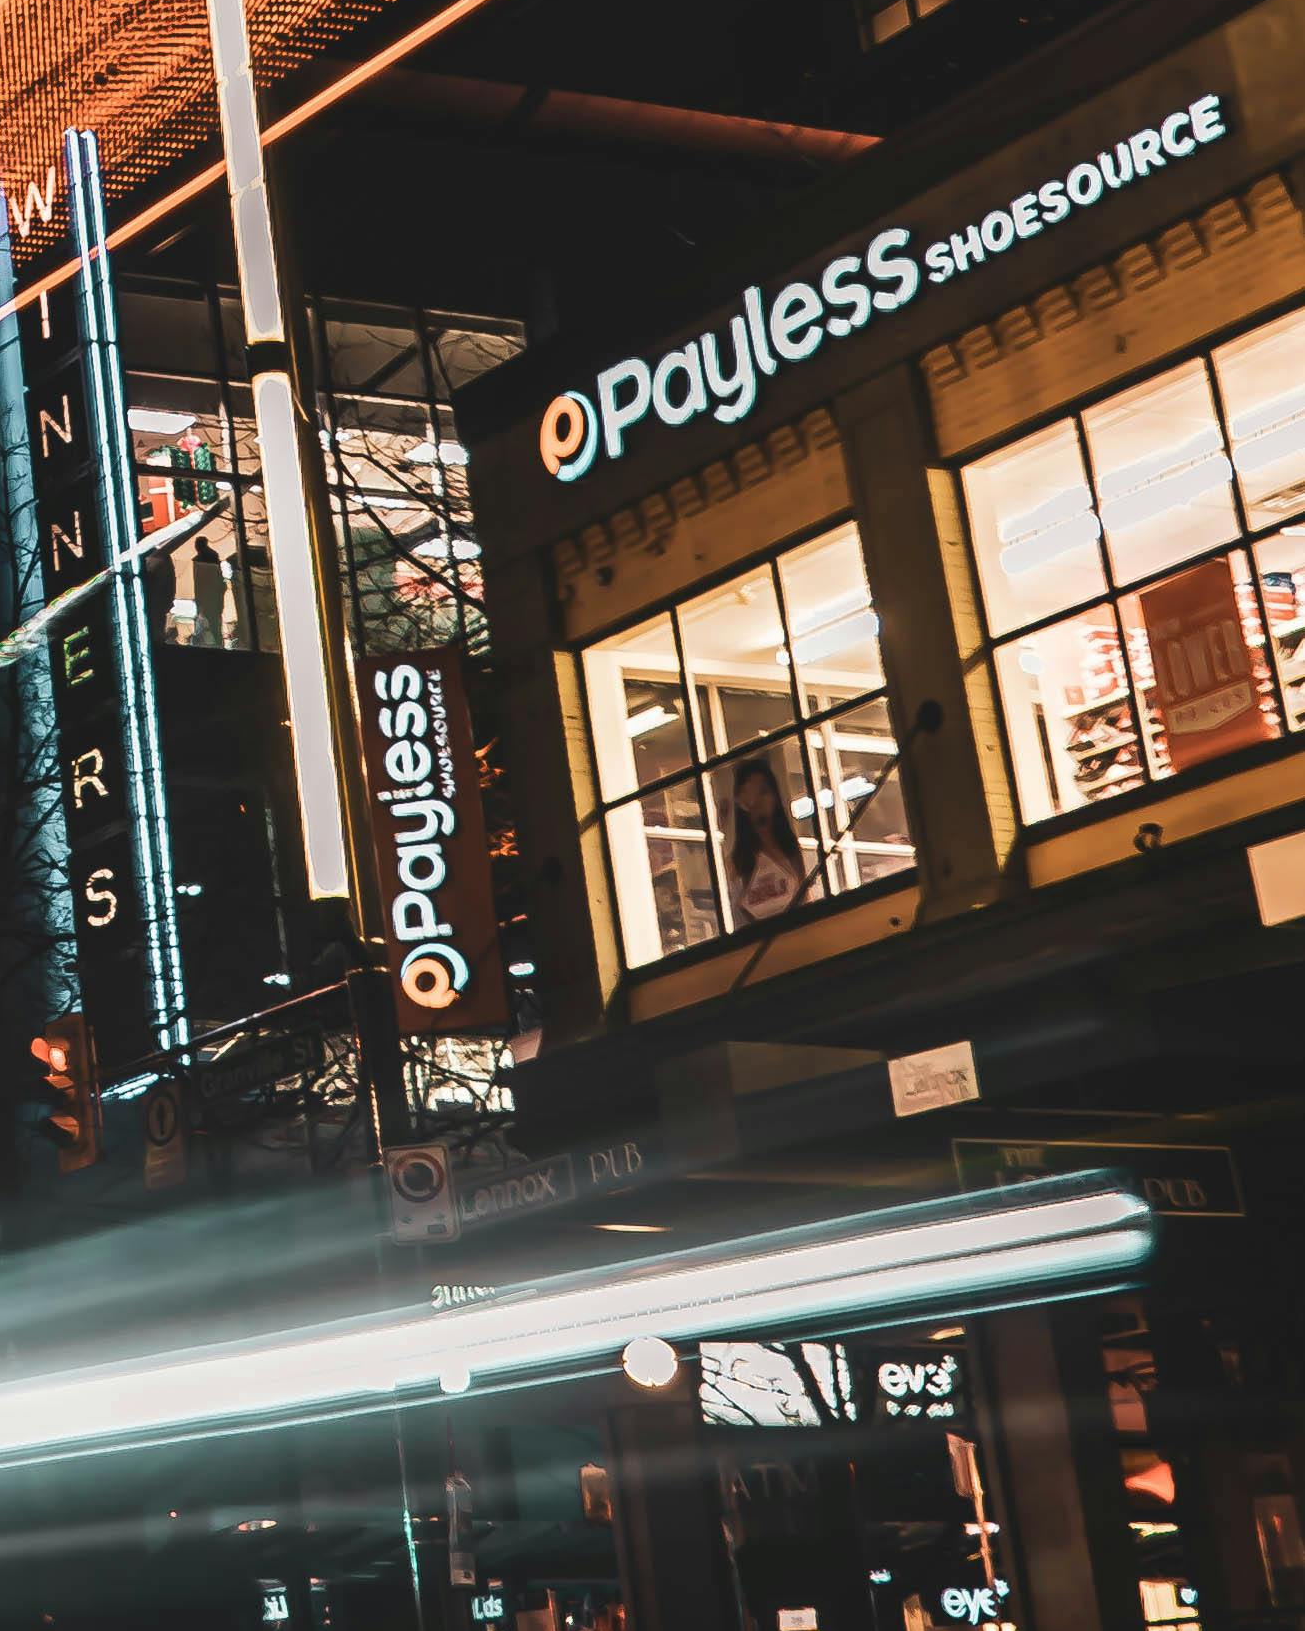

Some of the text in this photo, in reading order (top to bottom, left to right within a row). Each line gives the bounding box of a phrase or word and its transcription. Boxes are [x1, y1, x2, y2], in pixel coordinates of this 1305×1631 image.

[598, 93, 1227, 459] Payless SHOESOURCE
[10, 166, 118, 927] WINNERS
[375, 664, 455, 941] Payless
